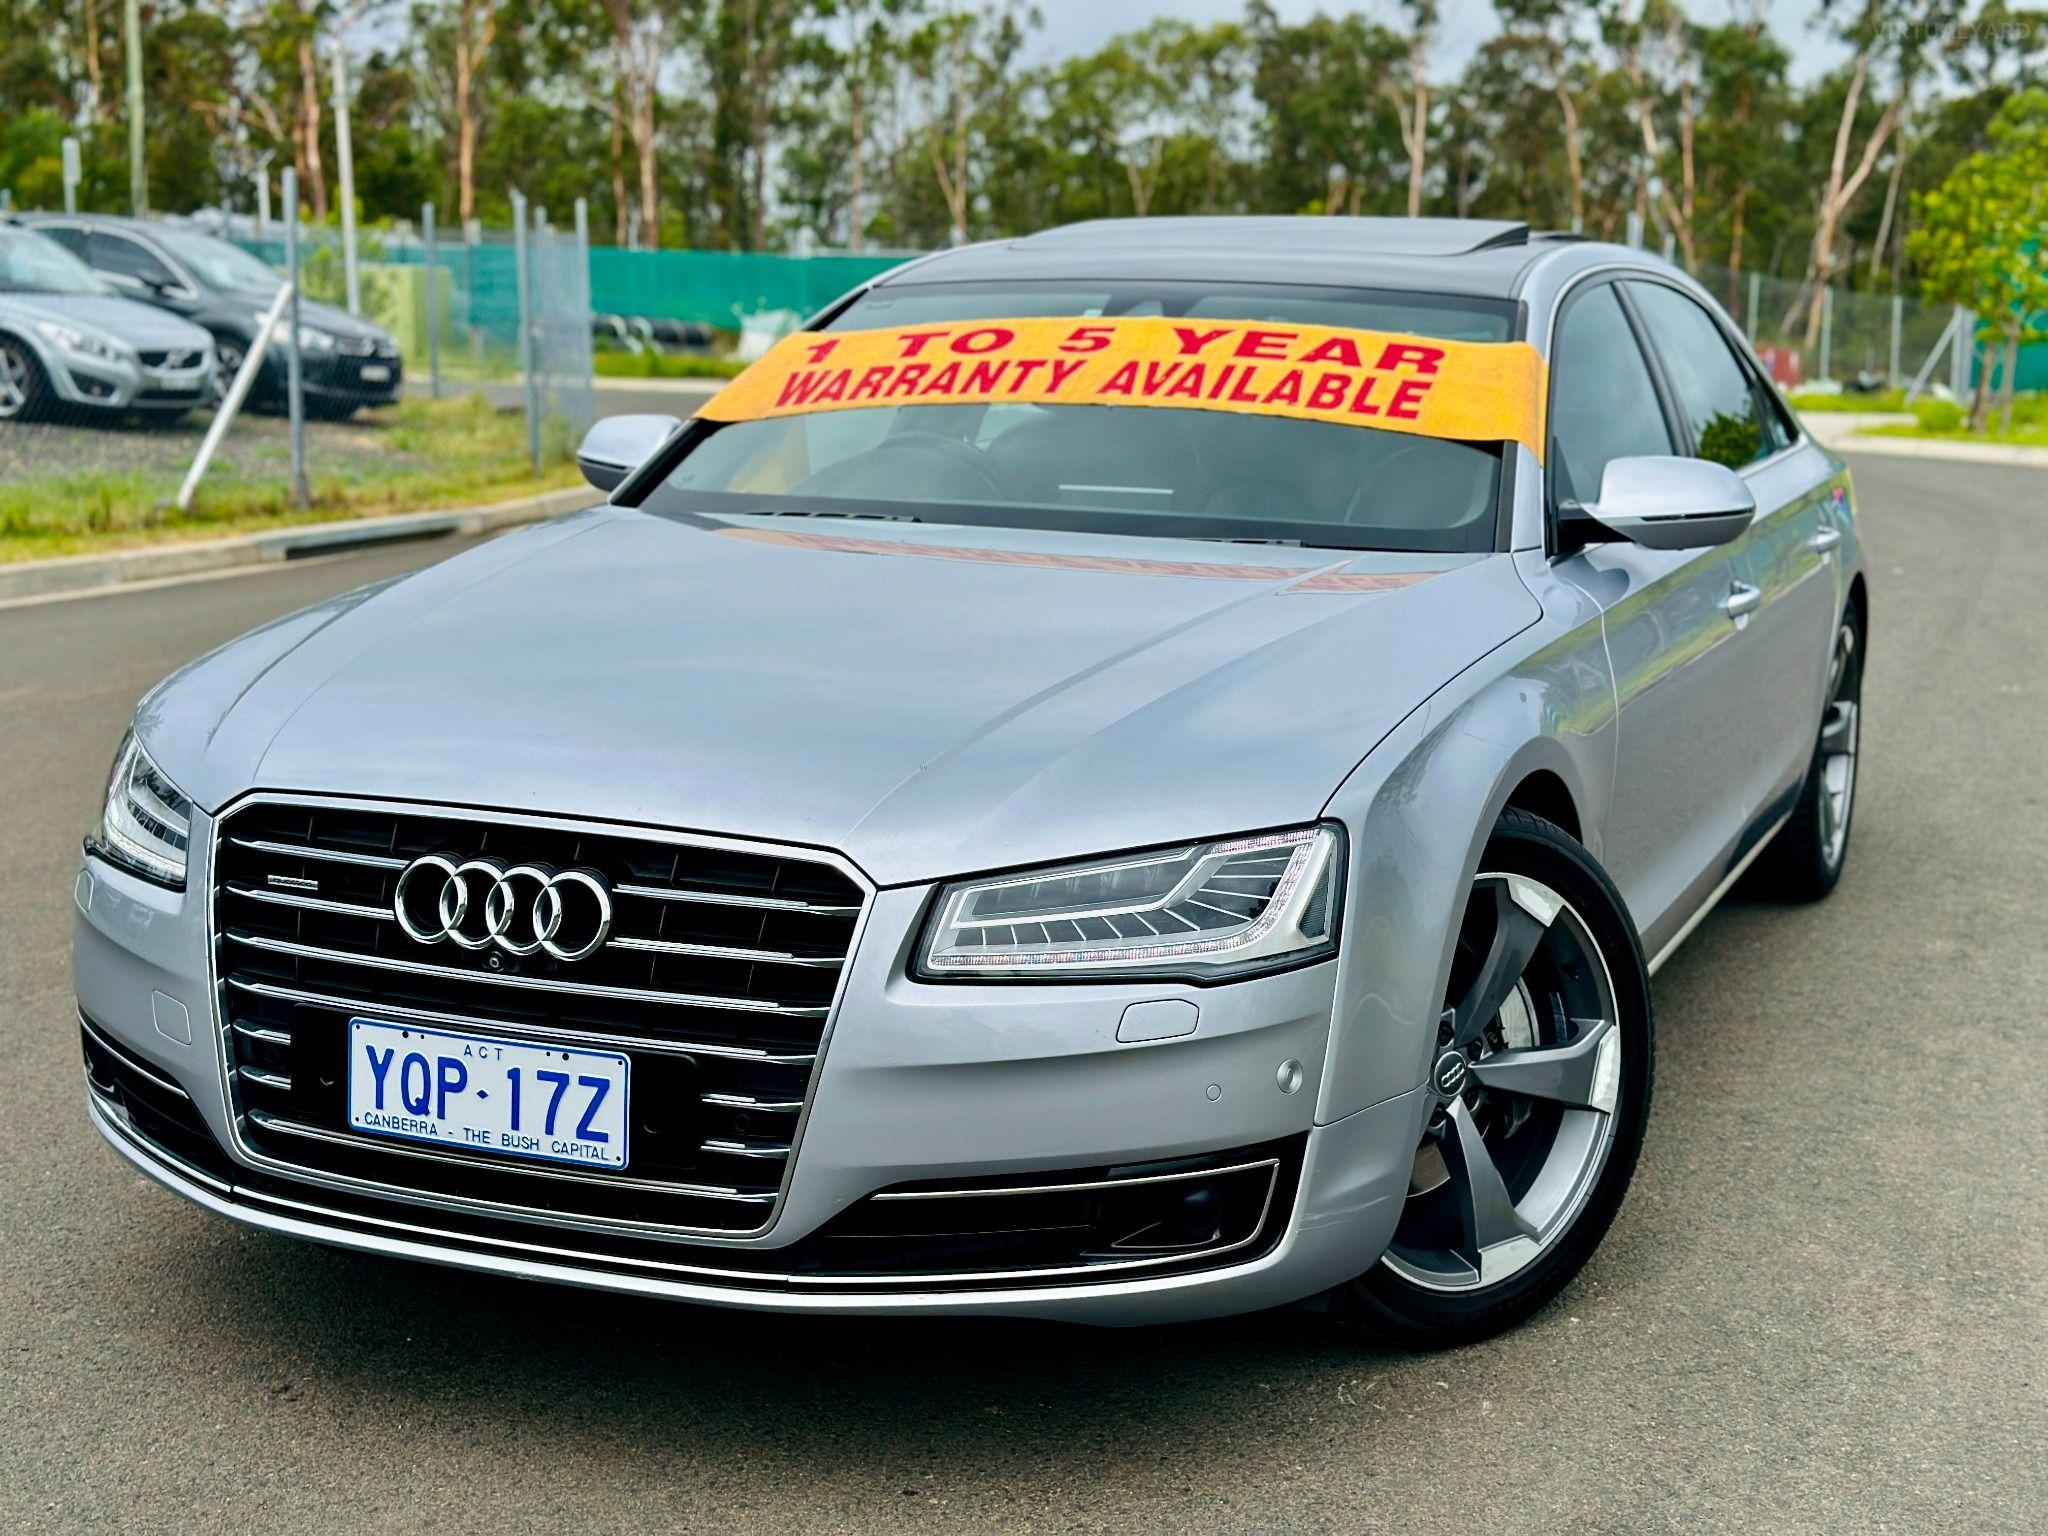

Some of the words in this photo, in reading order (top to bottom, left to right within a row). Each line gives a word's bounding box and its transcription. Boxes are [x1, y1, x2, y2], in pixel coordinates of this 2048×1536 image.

[806, 339, 841, 364] 1
[898, 328, 1015, 358] TO
[1058, 327, 1117, 352] 5
[1172, 327, 1446, 375] YEAR
[775, 360, 1088, 407] WARRANTY
[1096, 360, 1433, 420] AVAILABLE
[364, 1112, 438, 1136] CANBERRA
[463, 1127, 491, 1144] THE
[501, 1133, 539, 1151] BUSH
[551, 1140, 609, 1161] CAPITAL
